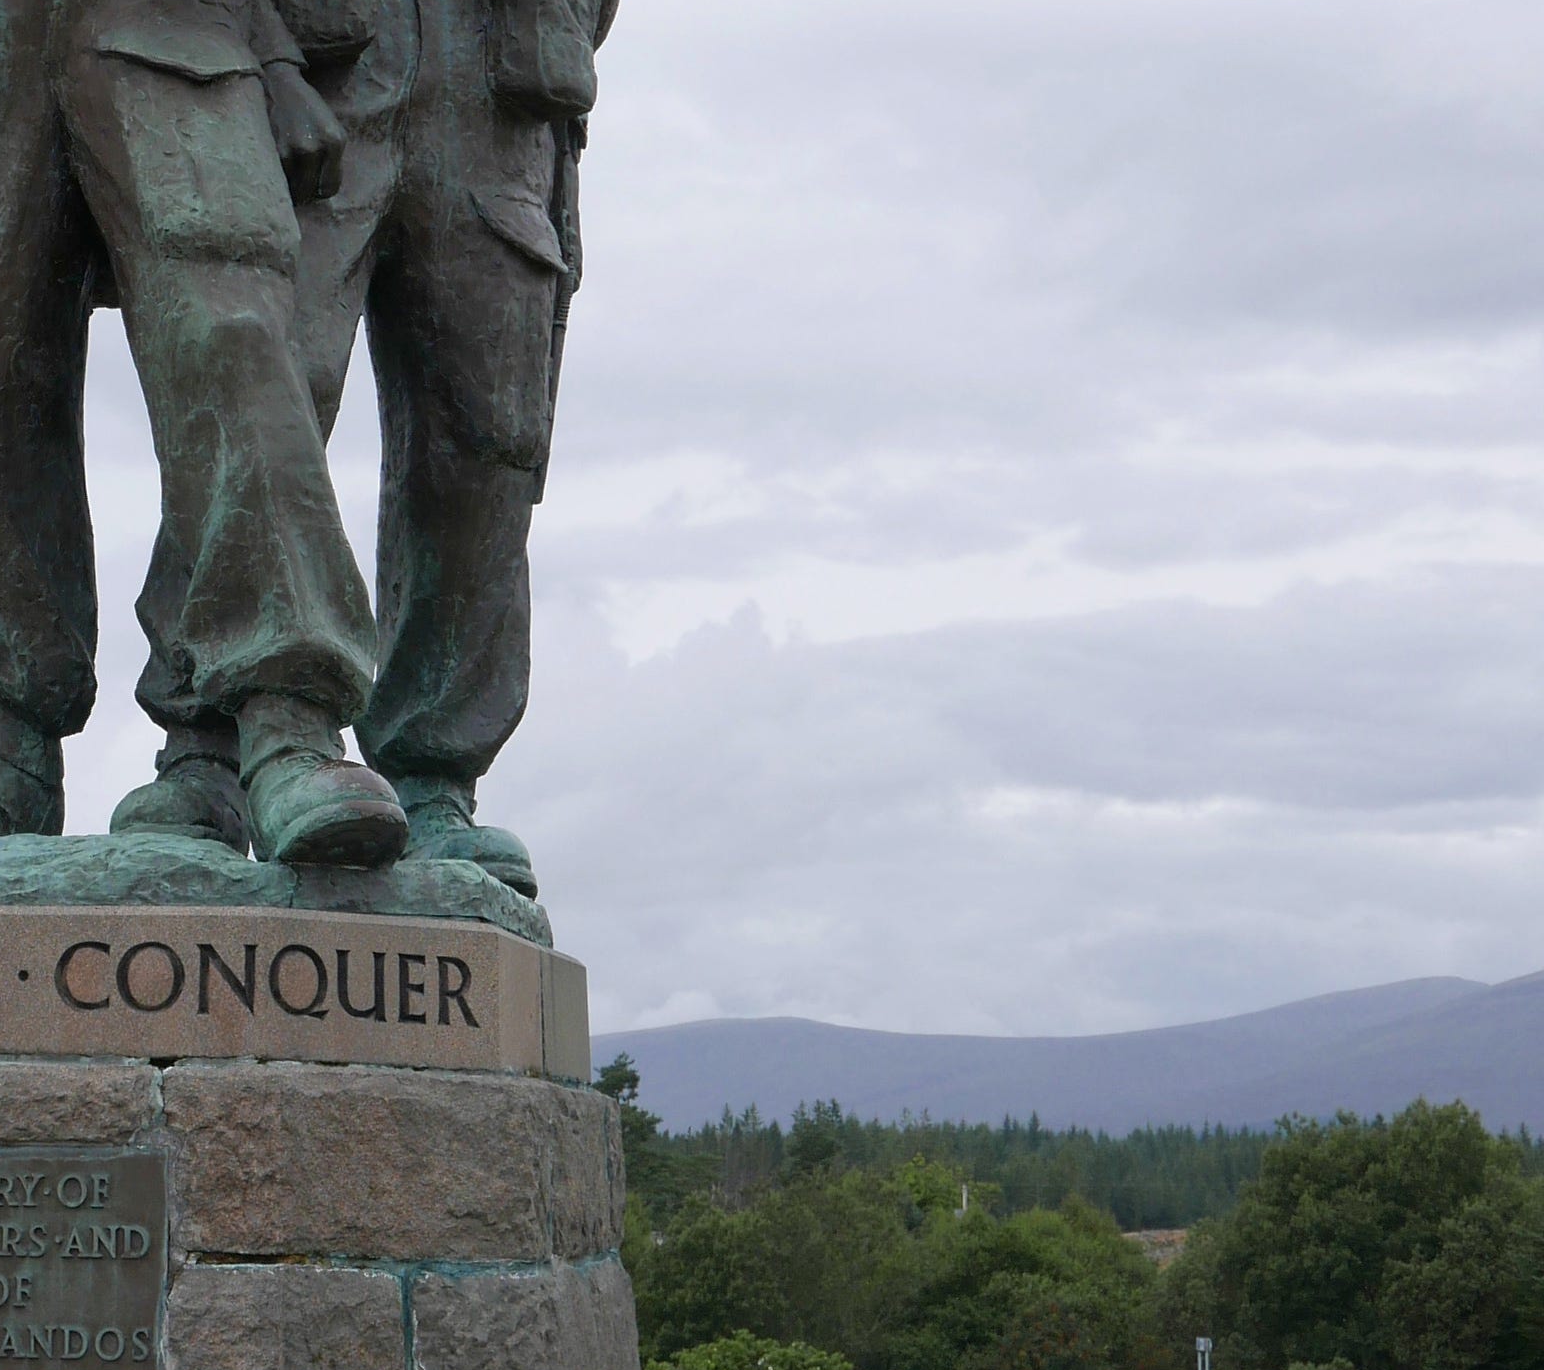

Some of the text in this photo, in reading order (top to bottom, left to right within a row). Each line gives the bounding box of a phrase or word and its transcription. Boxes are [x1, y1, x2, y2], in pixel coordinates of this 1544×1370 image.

[54, 940, 482, 1028] CONQUER
[56, 1173, 112, 1209] OF
[59, 1224, 151, 1260] AND
